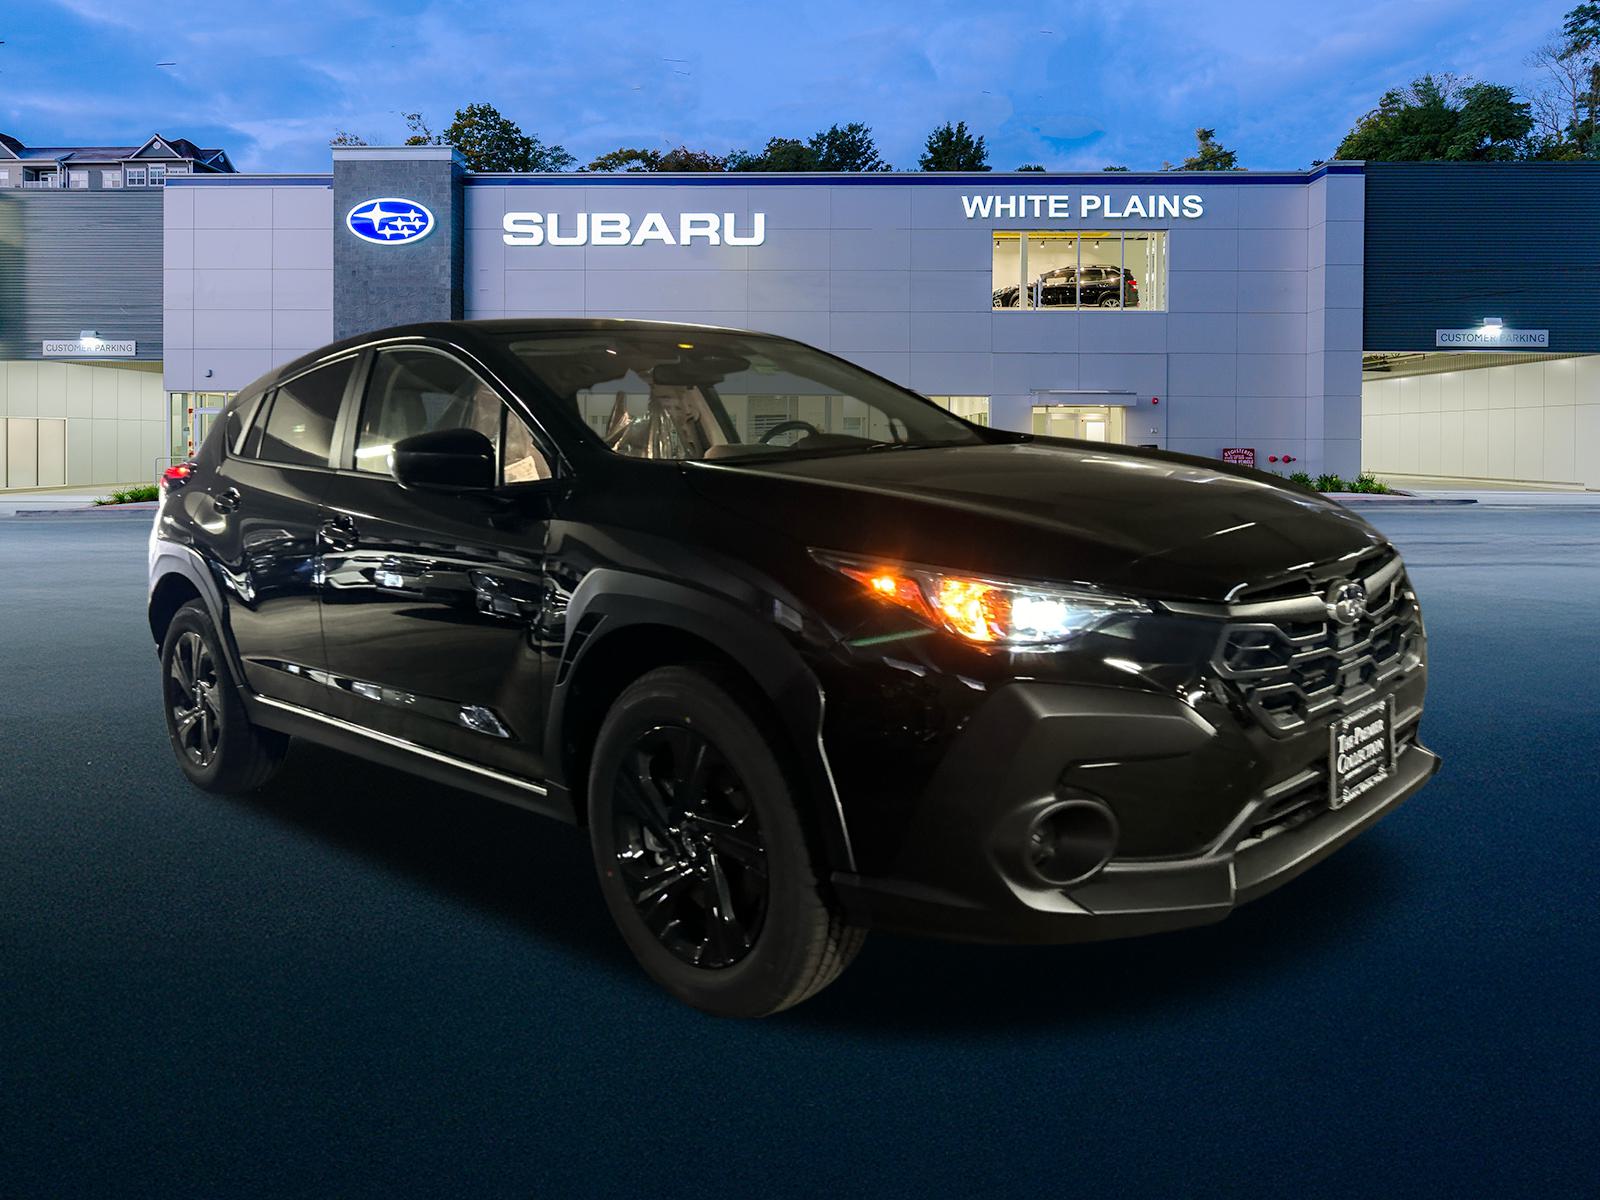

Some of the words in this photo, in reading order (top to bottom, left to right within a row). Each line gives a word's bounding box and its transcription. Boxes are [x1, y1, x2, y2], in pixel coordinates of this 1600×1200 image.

[961, 195, 1070, 218] WHITE
[1080, 194, 1204, 218] PLAINS
[502, 212, 766, 246] SUBARU
[1440, 333, 1497, 342] CUSTOMER
[1500, 333, 1545, 342] PARKING
[94, 344, 133, 352] PARKING
